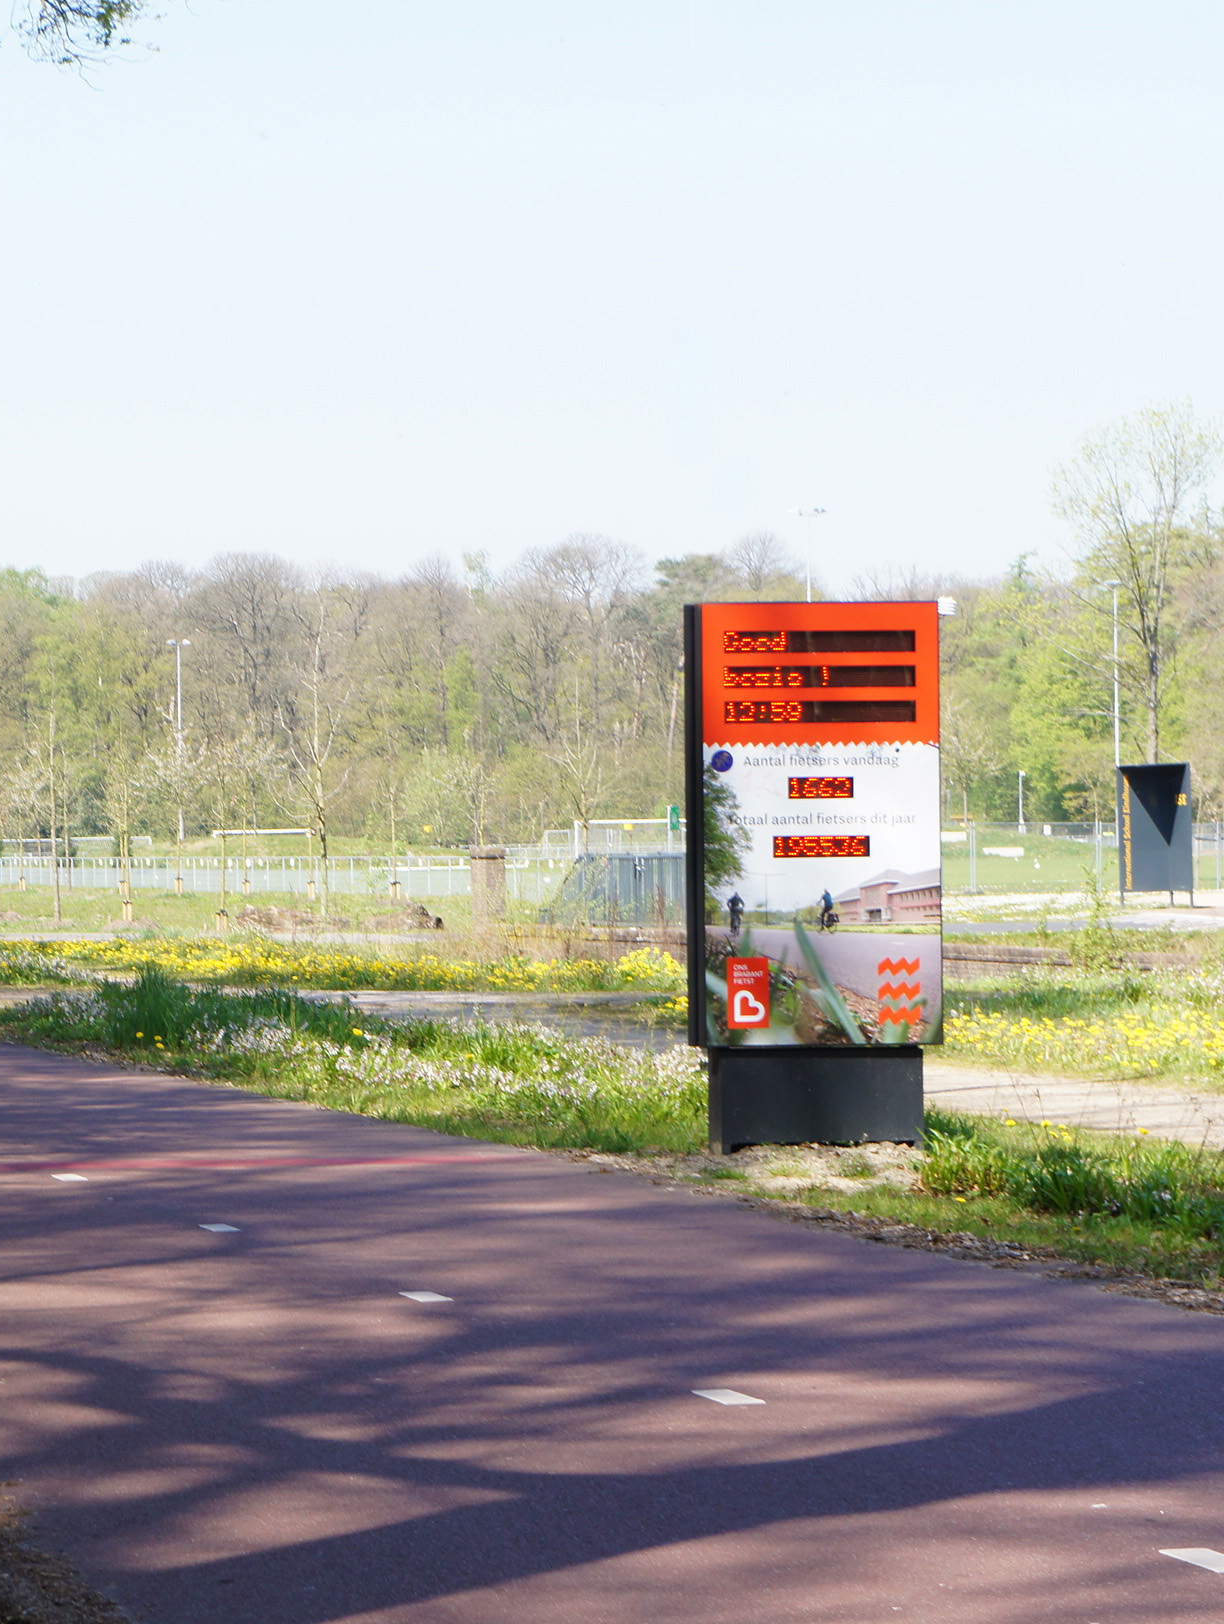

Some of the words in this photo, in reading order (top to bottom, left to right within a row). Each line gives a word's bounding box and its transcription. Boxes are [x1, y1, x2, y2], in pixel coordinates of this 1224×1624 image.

[822, 666, 829, 686] !
[743, 754, 785, 767] Aantal
[789, 755, 839, 767] fietsers
[843, 754, 899, 769] vandaag
[790, 777, 850, 798] 1662
[728, 813, 768, 826] Totaal
[772, 812, 812, 825] aantal
[817, 812, 866, 825] fietsers
[870, 812, 887, 824] dit
[890, 813, 917, 827] jaar
